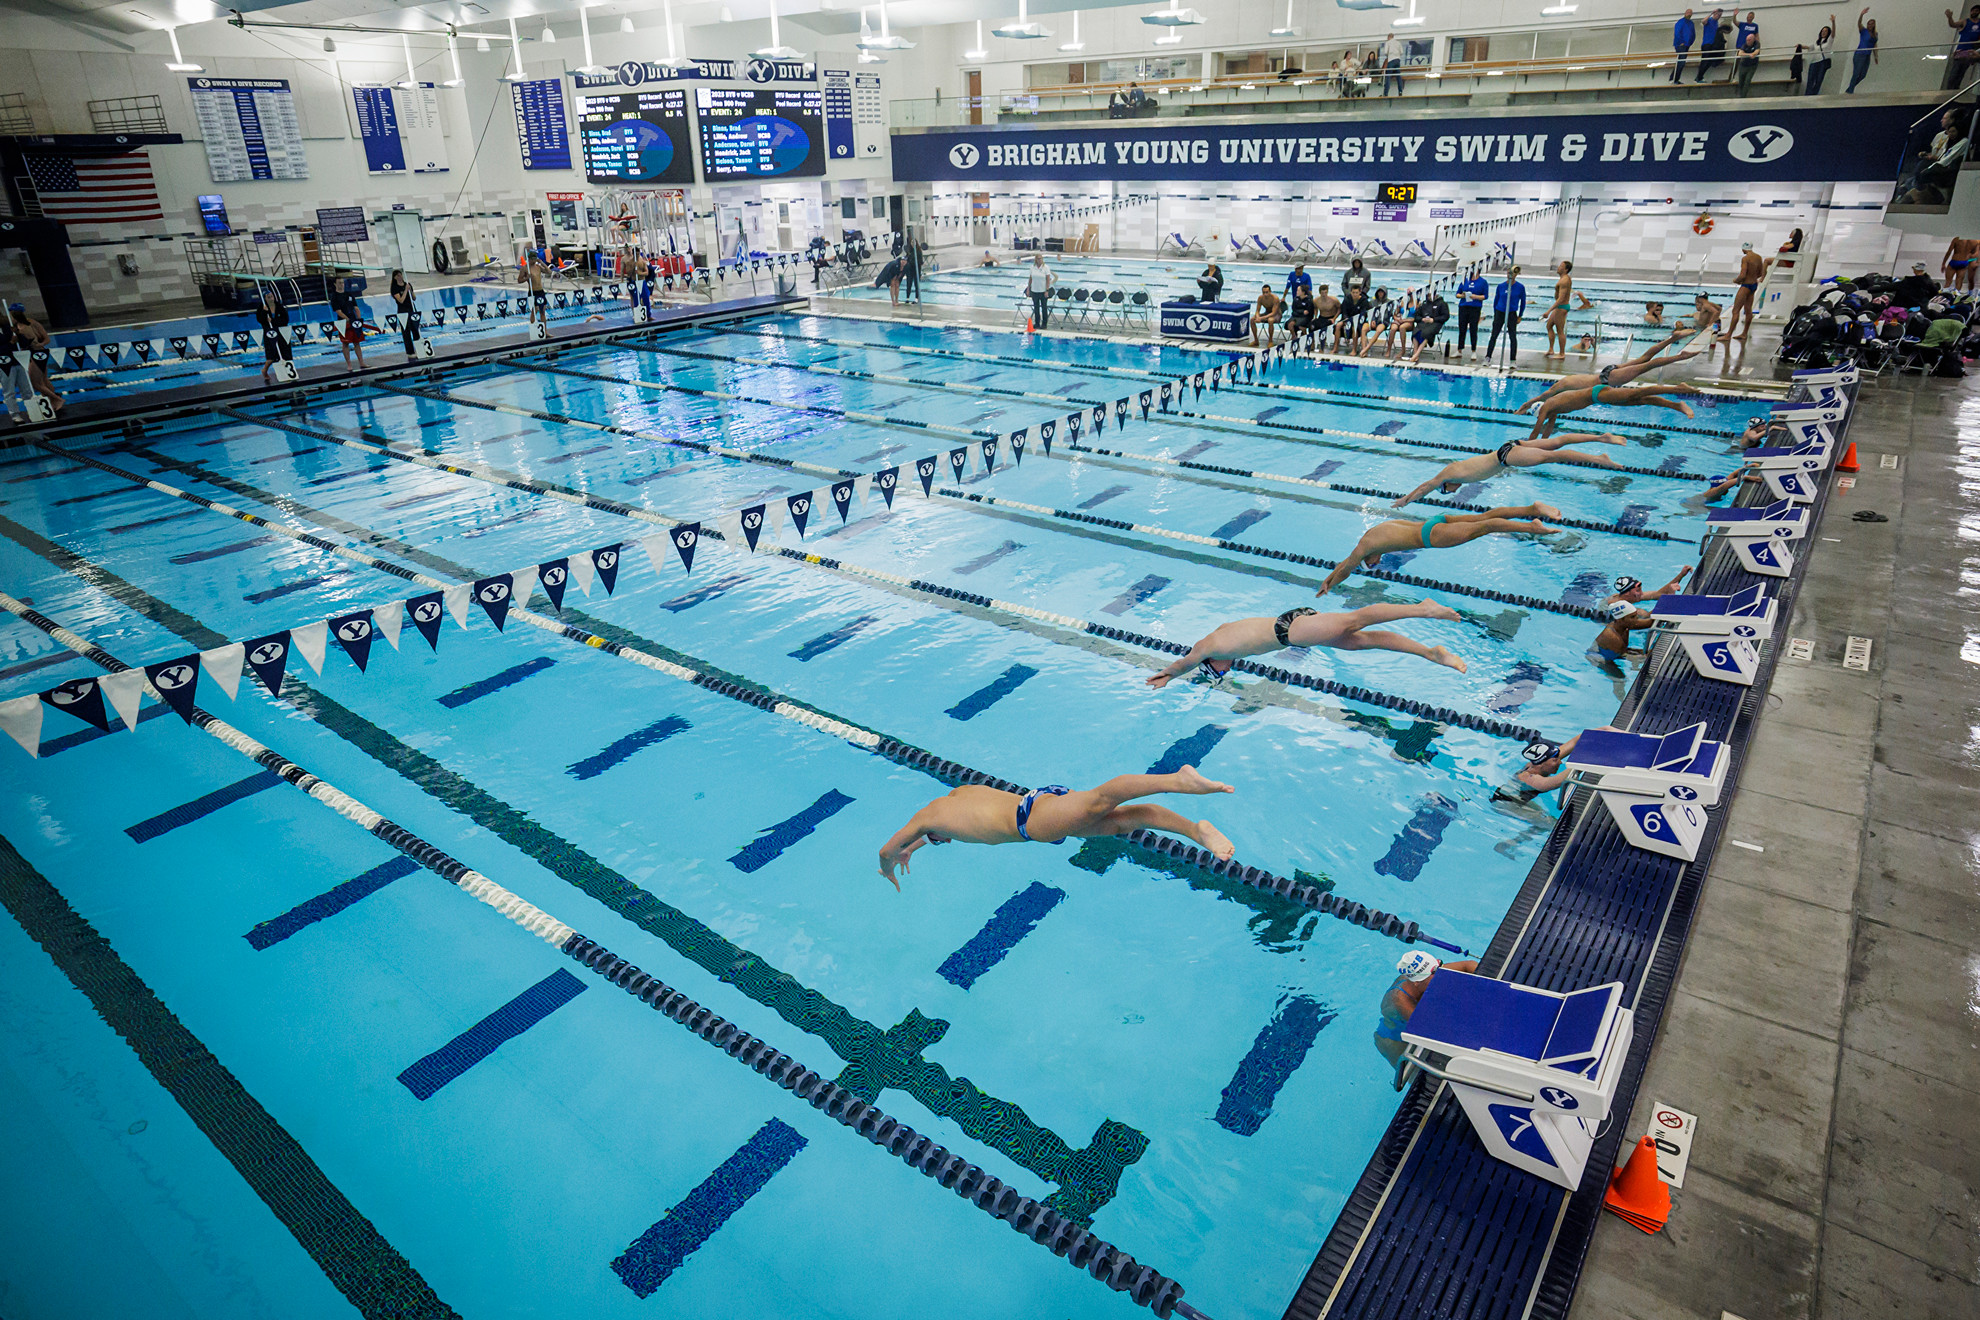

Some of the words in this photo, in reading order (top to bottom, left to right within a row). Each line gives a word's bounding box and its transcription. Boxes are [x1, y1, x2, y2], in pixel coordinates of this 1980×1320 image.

[622, 63, 638, 84] Y
[647, 66, 678, 79] DIVE
[700, 62, 742, 76] SWIM
[752, 61, 769, 81] Y
[779, 65, 810, 79] DIVE
[513, 85, 530, 157] OLYMPIANS
[955, 146, 974, 165] Y
[987, 142, 1106, 166] BRIGHAM
[1114, 140, 1209, 164] YOUNG
[1219, 136, 1425, 164] UNIVERSITY
[1435, 134, 1548, 162] SWIM
[1560, 133, 1587, 162] &
[1600, 131, 1709, 162] DIVE
[1740, 130, 1784, 159] Y
[1387, 186, 1414, 200] 9:27
[640, 307, 646, 321] 3
[1163, 318, 1185, 326] SWIM
[1190, 316, 1207, 330] Y
[1212, 321, 1232, 331] DIVE
[537, 324, 545, 338] 3
[423, 340, 433, 356] 3
[284, 362, 297, 379] 3
[40, 399, 53, 418] 3
[1044, 427, 1052, 437] Y
[1809, 429, 1818, 440] 2
[1014, 436, 1022, 446] Y
[986, 445, 995, 455] Y
[954, 454, 963, 465] Y
[922, 464, 932, 475] Y
[883, 475, 893, 487] Y
[1785, 478, 1796, 491] 3
[838, 488, 848, 500] Y
[794, 500, 806, 513] Y
[747, 514, 758, 528] Y
[680, 532, 692, 546] Y
[1777, 528, 1790, 537] Y
[601, 553, 614, 567] Y
[1756, 548, 1769, 562] 4
[547, 568, 561, 584] Y
[484, 585, 504, 601] Y
[418, 603, 437, 620] Y
[342, 622, 366, 640] Y
[1737, 626, 1753, 637] Y
[255, 644, 279, 662] Y
[1712, 648, 1728, 665] 5
[159, 666, 186, 687] Y
[63, 683, 86, 700] Y
[1526, 744, 1543, 758] Y
[1674, 787, 1694, 800] Y
[1643, 811, 1662, 833] 6
[1546, 1088, 1573, 1108] Y
[1509, 1113, 1532, 1142] 7
